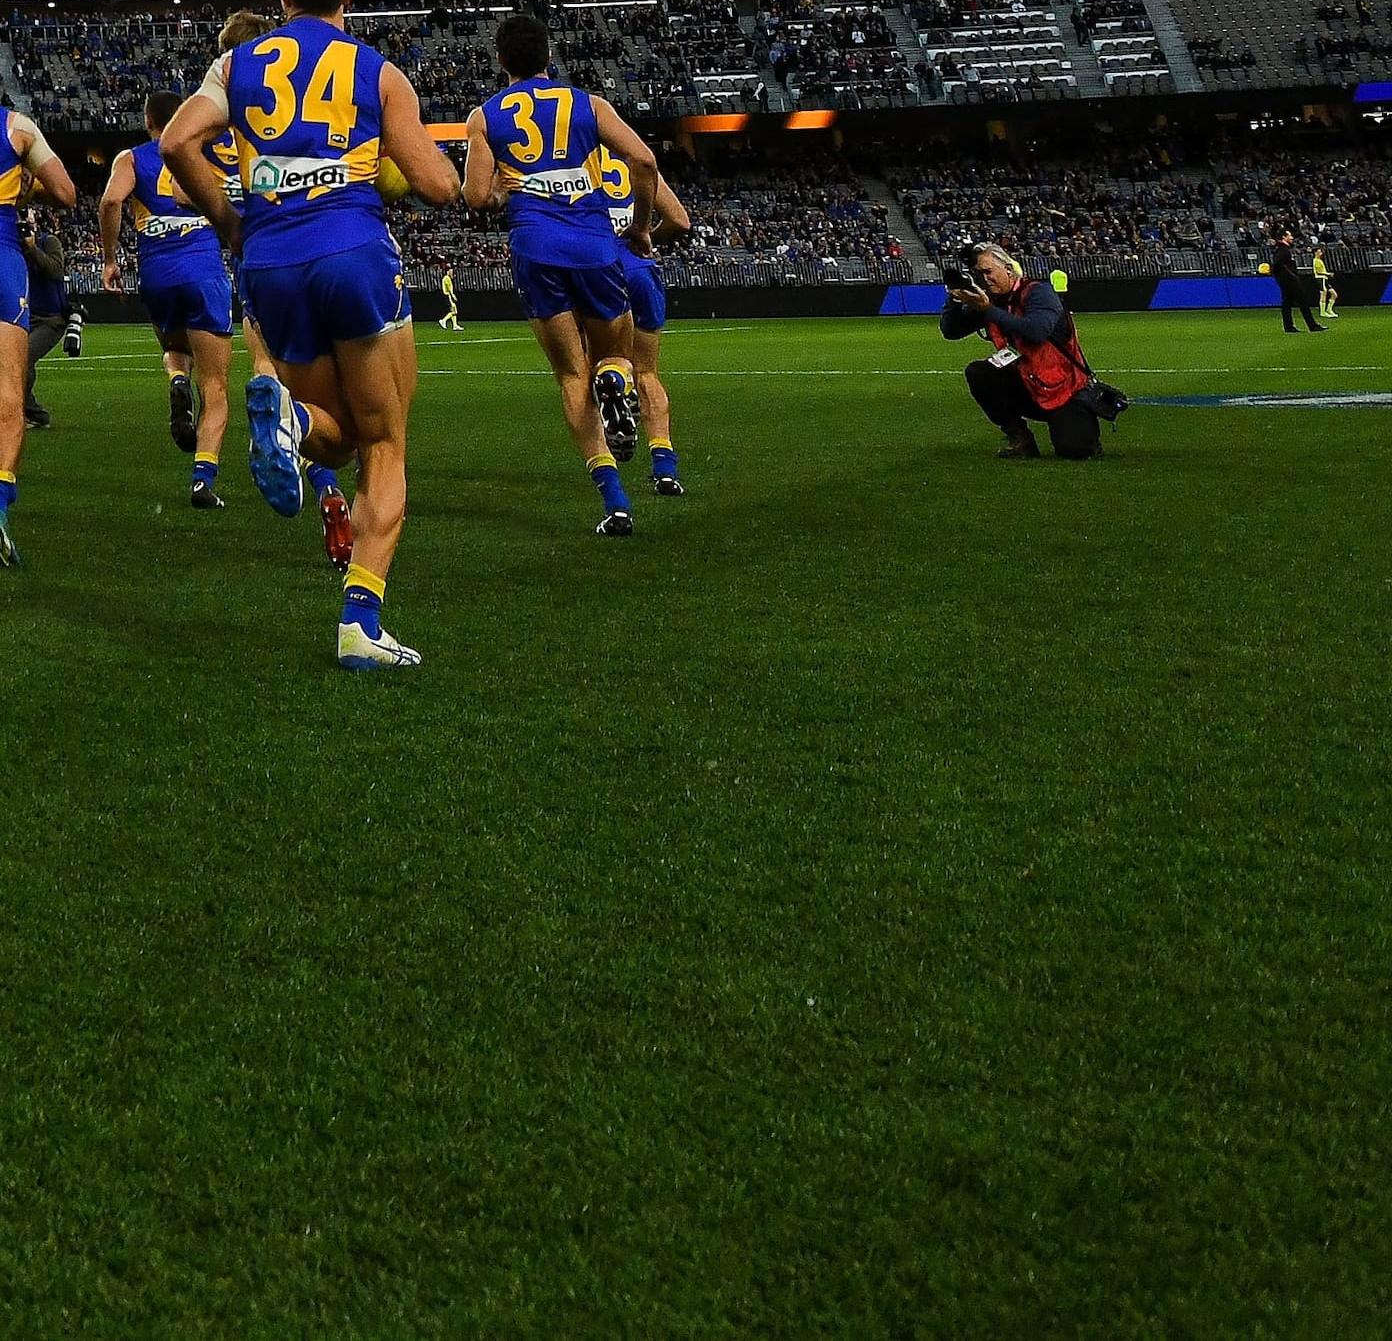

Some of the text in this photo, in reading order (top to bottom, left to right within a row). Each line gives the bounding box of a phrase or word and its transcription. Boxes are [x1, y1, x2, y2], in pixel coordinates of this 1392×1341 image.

[245, 36, 358, 150] 34
[500, 88, 574, 164] 37
[279, 168, 345, 189] lendi
[547, 175, 592, 194] lendi
